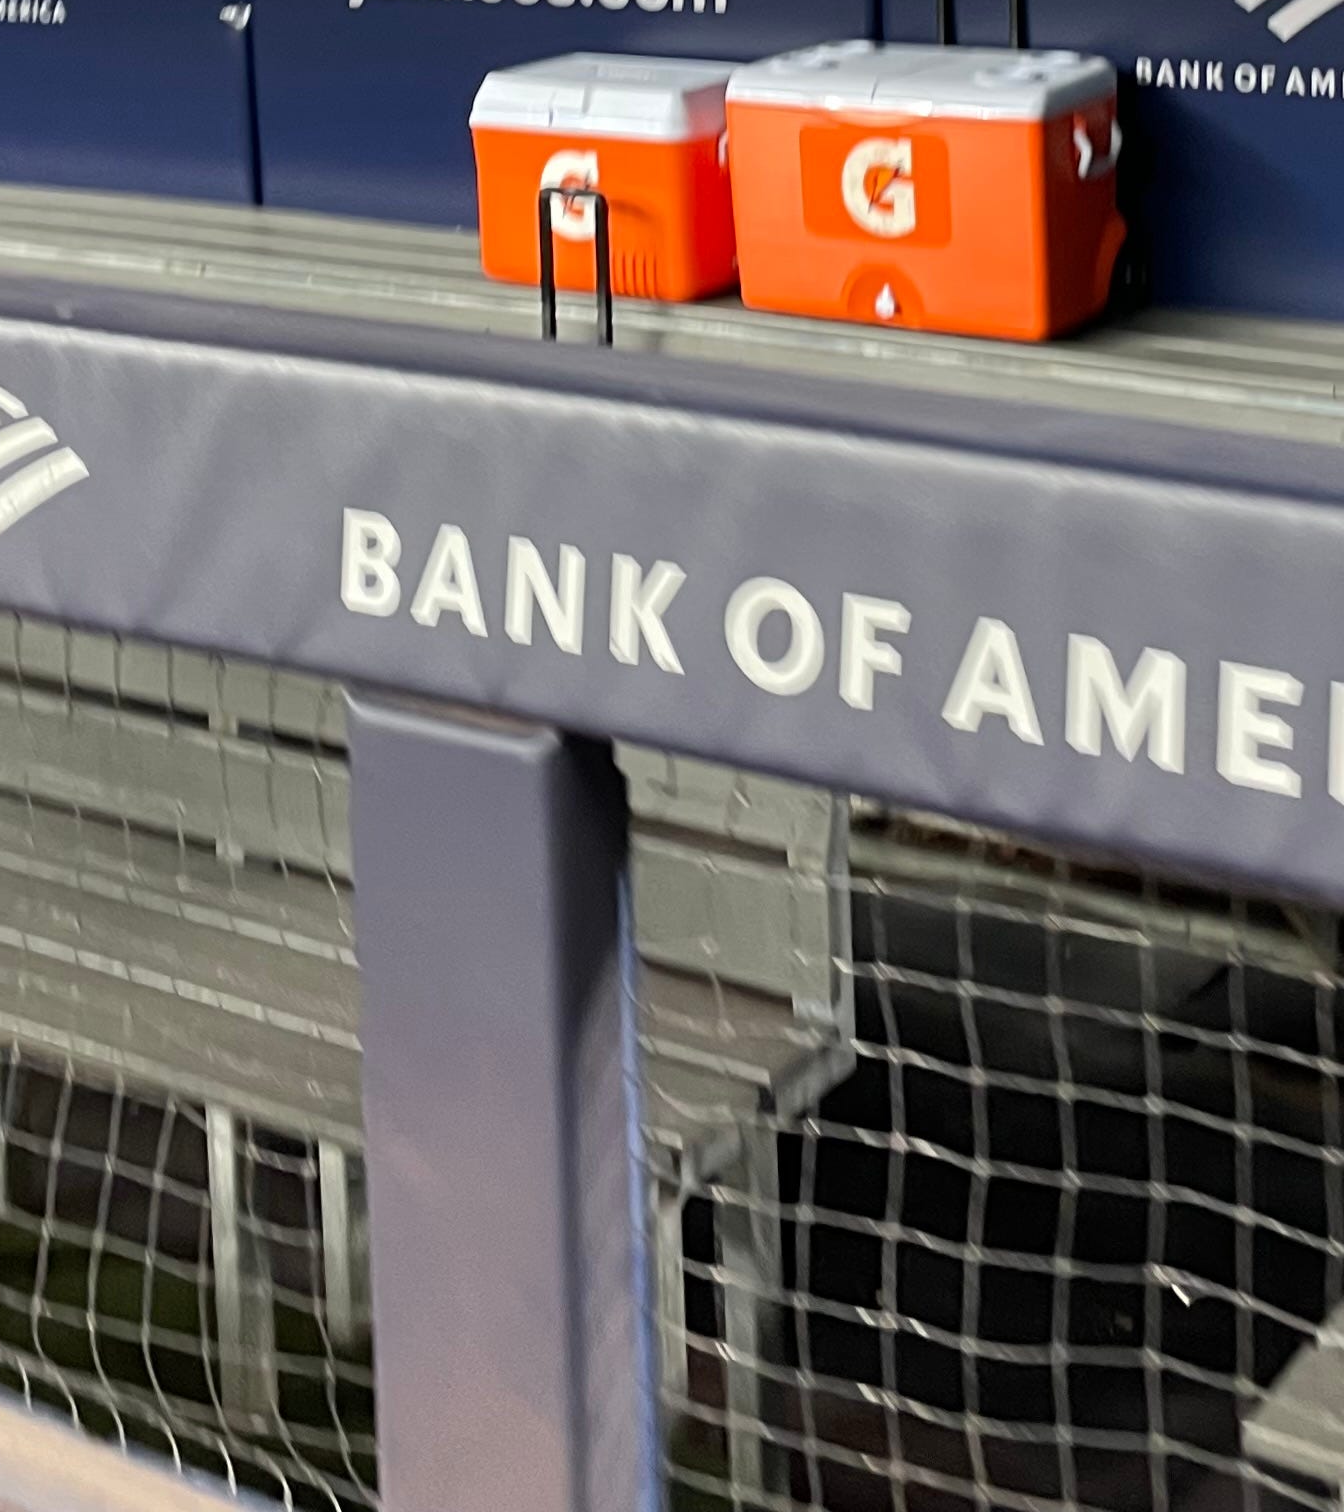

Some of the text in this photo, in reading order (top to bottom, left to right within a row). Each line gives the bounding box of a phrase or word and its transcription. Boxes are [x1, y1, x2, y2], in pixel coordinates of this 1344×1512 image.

[1136, 56, 1224, 92] BANK
[1234, 63, 1276, 94] OF
[841, 137, 916, 238] G
[340, 507, 686, 675] BANK
[722, 575, 911, 712] OF
